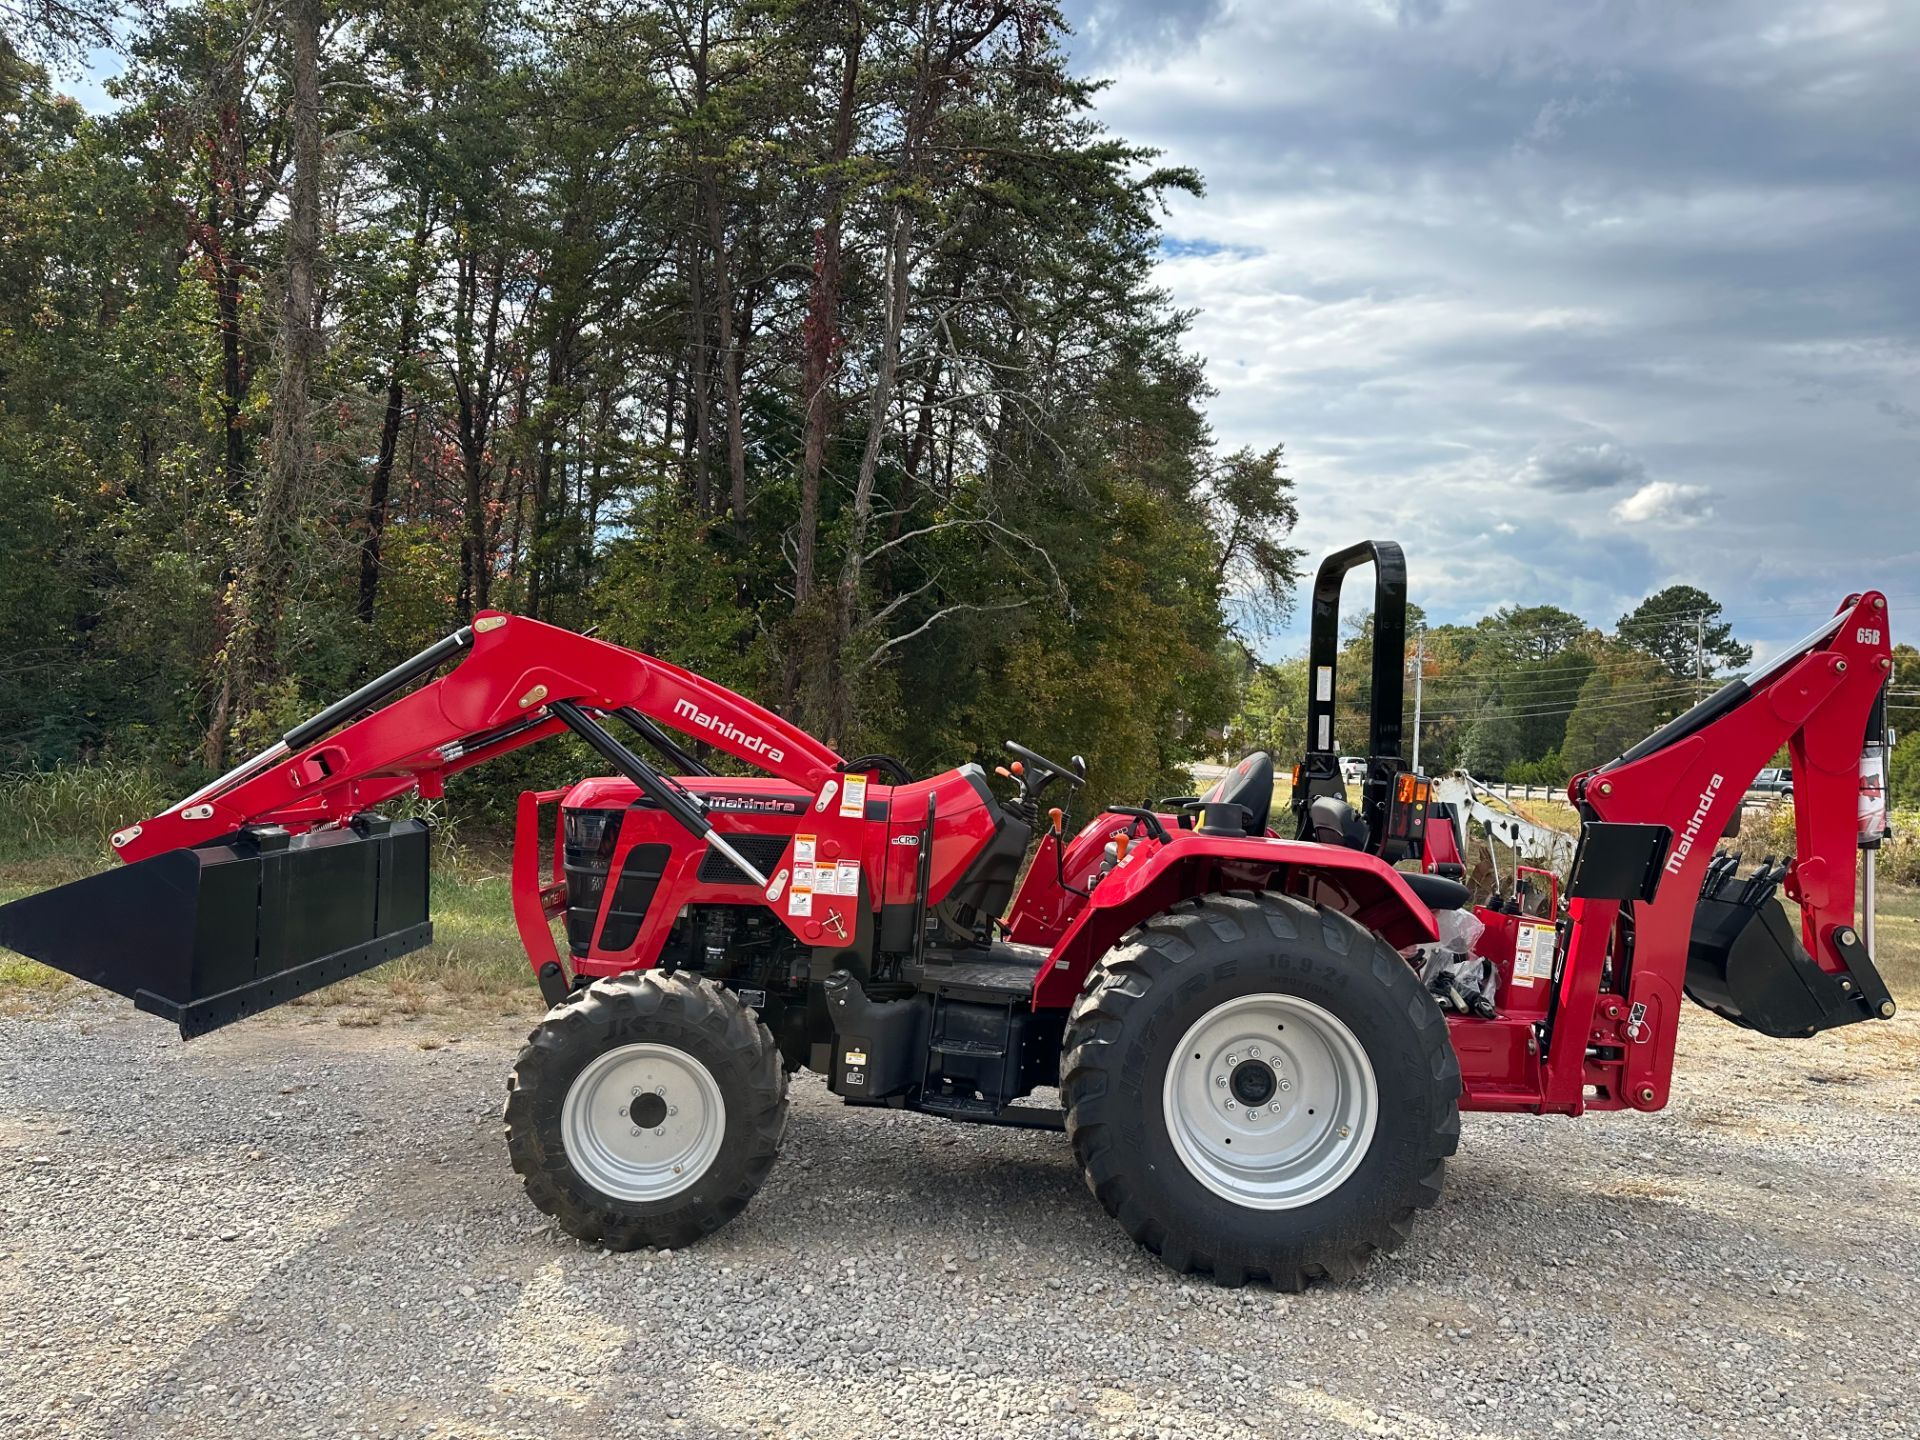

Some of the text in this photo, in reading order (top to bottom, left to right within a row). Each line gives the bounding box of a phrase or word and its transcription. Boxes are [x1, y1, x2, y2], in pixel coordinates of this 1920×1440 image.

[1856, 627, 1881, 646] 65B
[674, 698, 785, 763] Mahindra
[708, 795, 796, 813] Mahindra
[1664, 774, 1724, 876] Mahindra
[1266, 953, 1350, 989] 16.9-24
